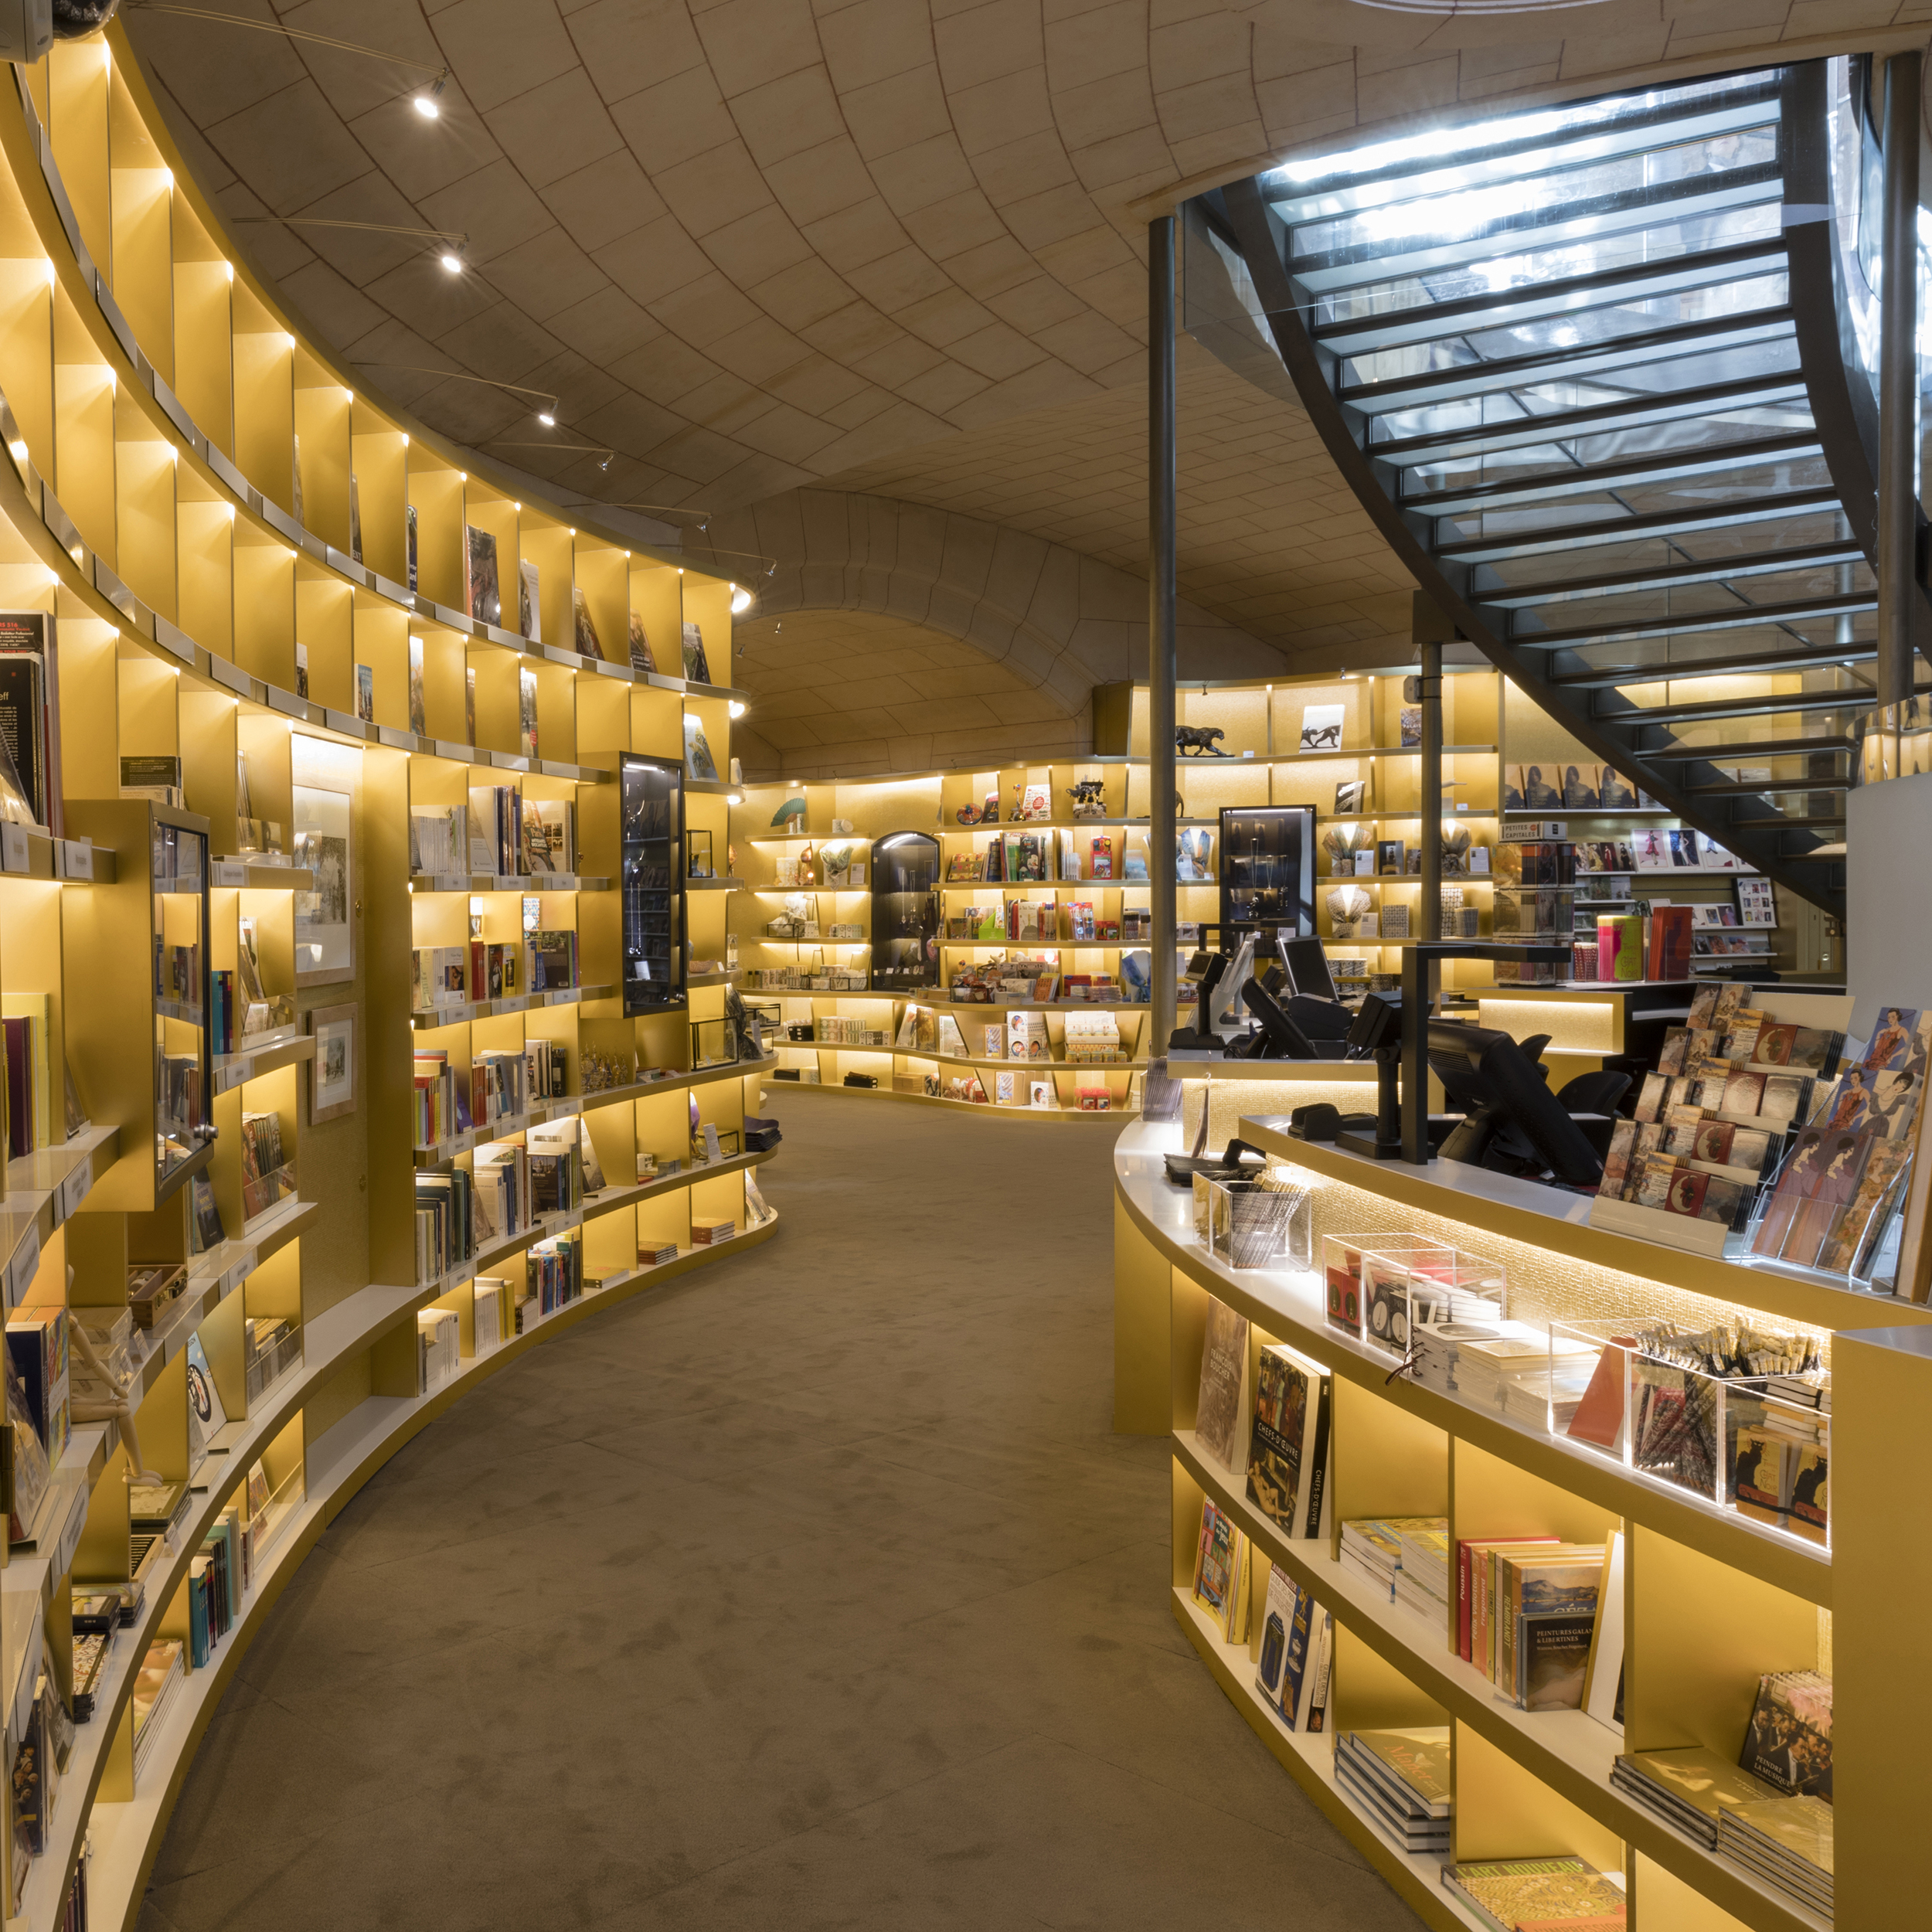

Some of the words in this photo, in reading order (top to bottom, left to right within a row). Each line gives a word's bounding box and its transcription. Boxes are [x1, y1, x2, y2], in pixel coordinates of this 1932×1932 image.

[1209, 1359, 1230, 1382] BOUCHER
[1210, 1348, 1232, 1371] FRANÇOIS
[1257, 1422, 1298, 1460] CHEFS-D'ŒUVRE
[1311, 1469, 1322, 1526] CHEFS-D'ŒUVRE
[1270, 1572, 1281, 1587] GUIDE
[1383, 1746, 1432, 1780] Manet
[1756, 1755, 1783, 1775] PEINDRE
[1762, 1767, 1791, 1788] MUSIQUE
[1455, 1865, 1502, 1879] L'ART
[1502, 1860, 1583, 1876] NOUVEAU
[1534, 1921, 1627, 1932] 'PRESSION
